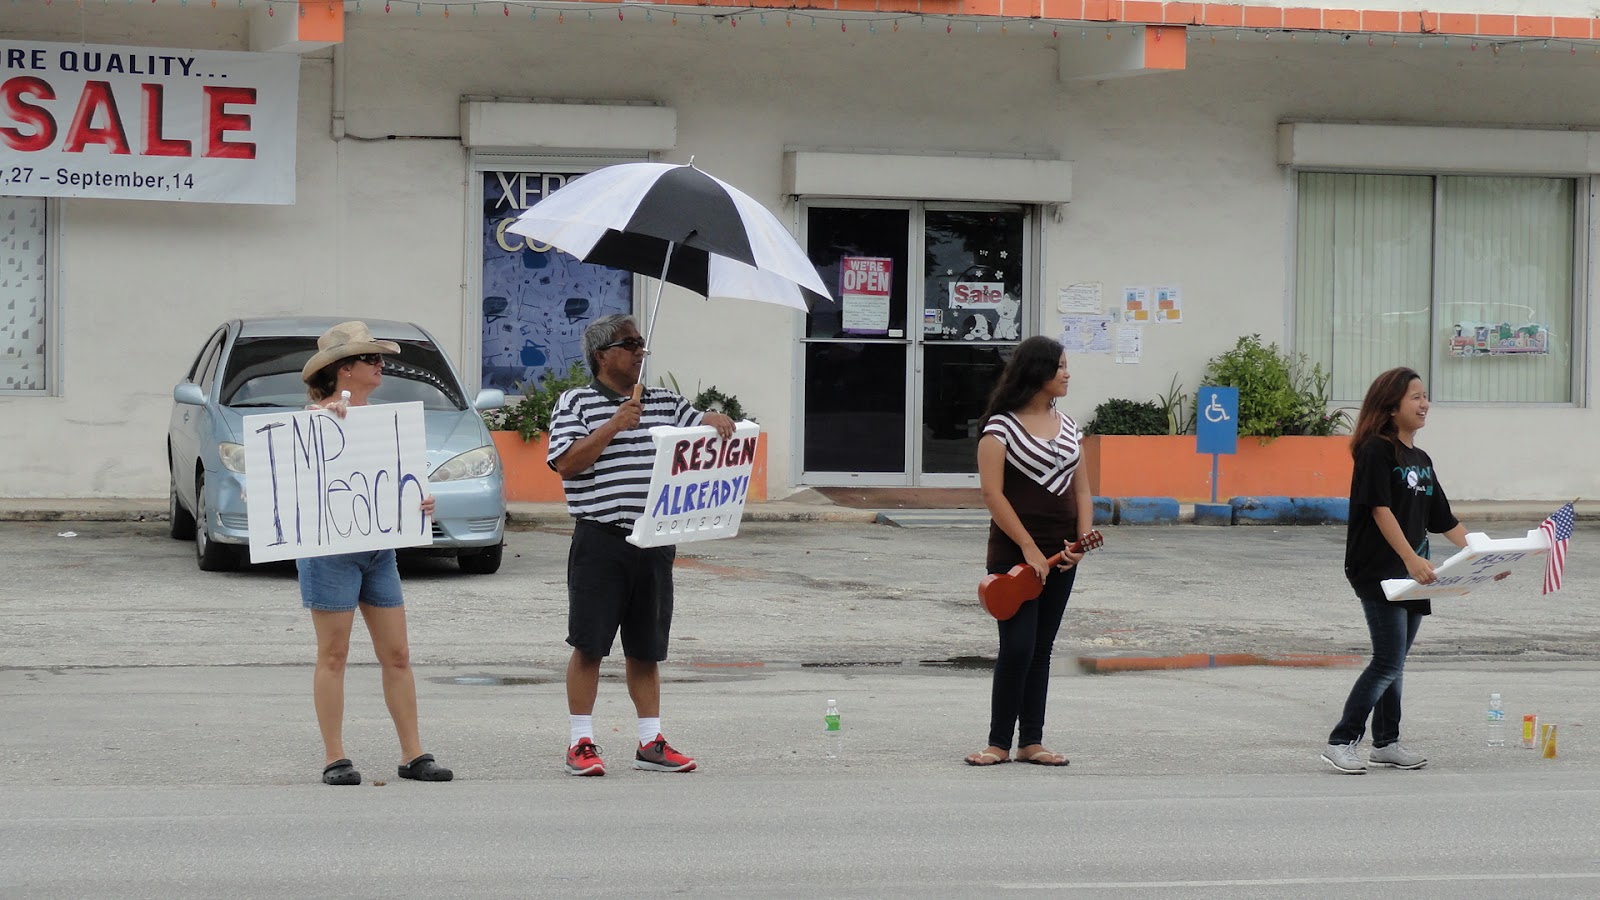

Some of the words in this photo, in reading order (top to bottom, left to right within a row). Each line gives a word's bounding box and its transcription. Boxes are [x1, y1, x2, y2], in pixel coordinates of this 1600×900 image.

[0, 49, 47, 70] RE
[59, 50, 228, 78] QUALITY...
[0, 76, 257, 159] SALE
[56, 168, 194, 190] September,14
[495, 172, 581, 209] XER
[850, 260, 884, 272] WE'RE
[844, 269, 889, 291] OPEN
[954, 284, 1002, 304] Sale
[671, 436, 757, 476] RESIGN
[652, 475, 749, 518] ALREADY!
[1471, 552, 1526, 566] BASTA
